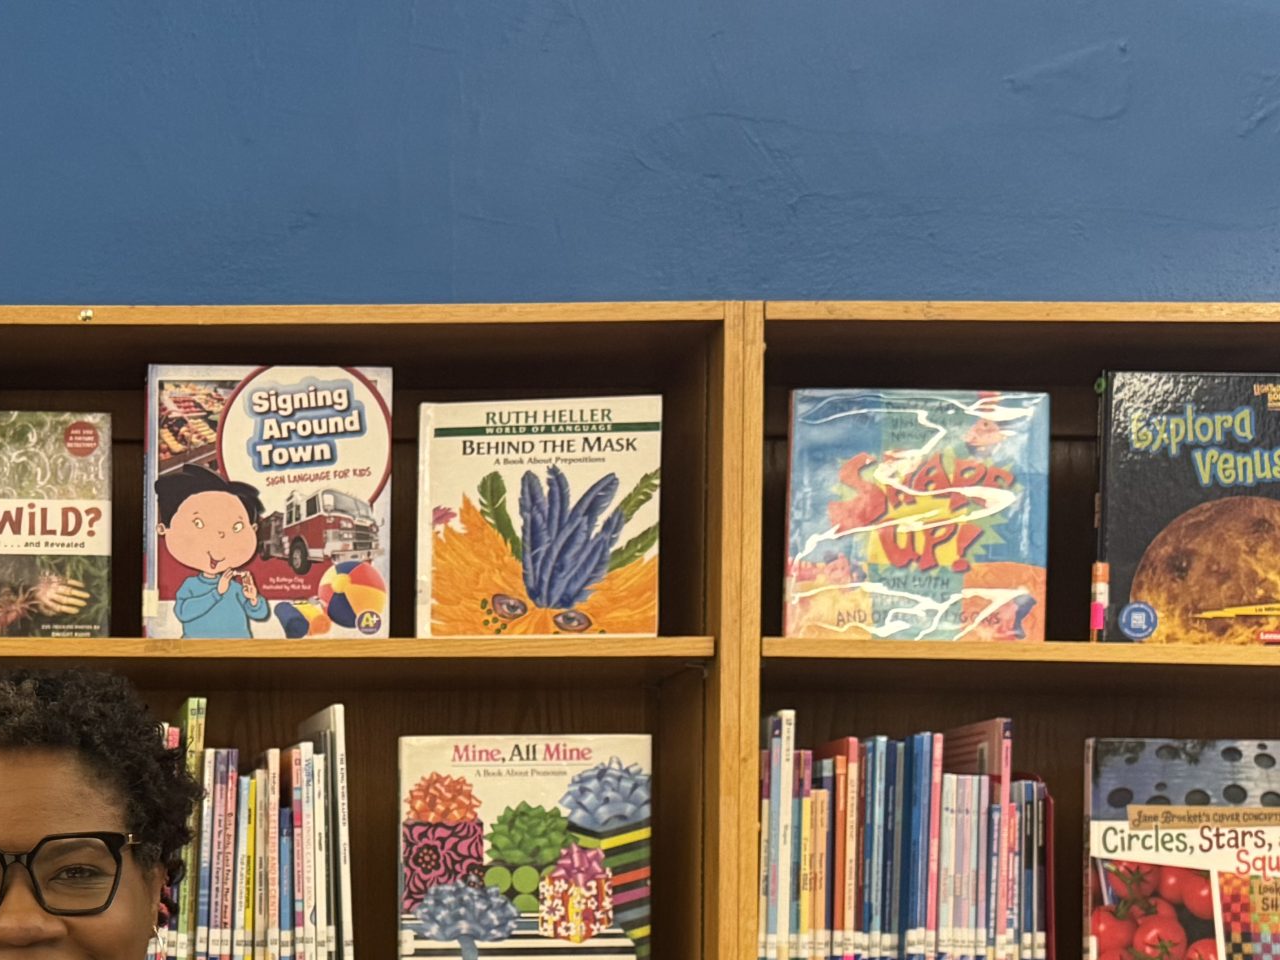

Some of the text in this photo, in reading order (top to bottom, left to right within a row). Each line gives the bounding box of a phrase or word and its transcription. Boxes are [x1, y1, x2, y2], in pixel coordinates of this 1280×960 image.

[251, 385, 350, 416] Signing
[262, 410, 361, 441] Around
[485, 408, 613, 426] RUTH HELLER
[485, 424, 613, 435] WORLD OF LANGUAGE
[1130, 405, 1254, 455] Explora
[254, 442, 333, 466] Town
[462, 436, 638, 456] BEHIND THE MASK
[493, 456, 607, 466] A Book About Prepositions
[265, 467, 372, 487] SIGN LANGUAGE FOR KIDS
[24, 540, 41, 548] and
[44, 540, 86, 549] Revealed
[450, 743, 593, 763] Mine, All Mine
[474, 768, 568, 778] A Book About Pronouns
[1132, 810, 1159, 828] Jane
[1101, 825, 1273, 856] Circles, Stars,
[1236, 849, 1280, 882] Squ
